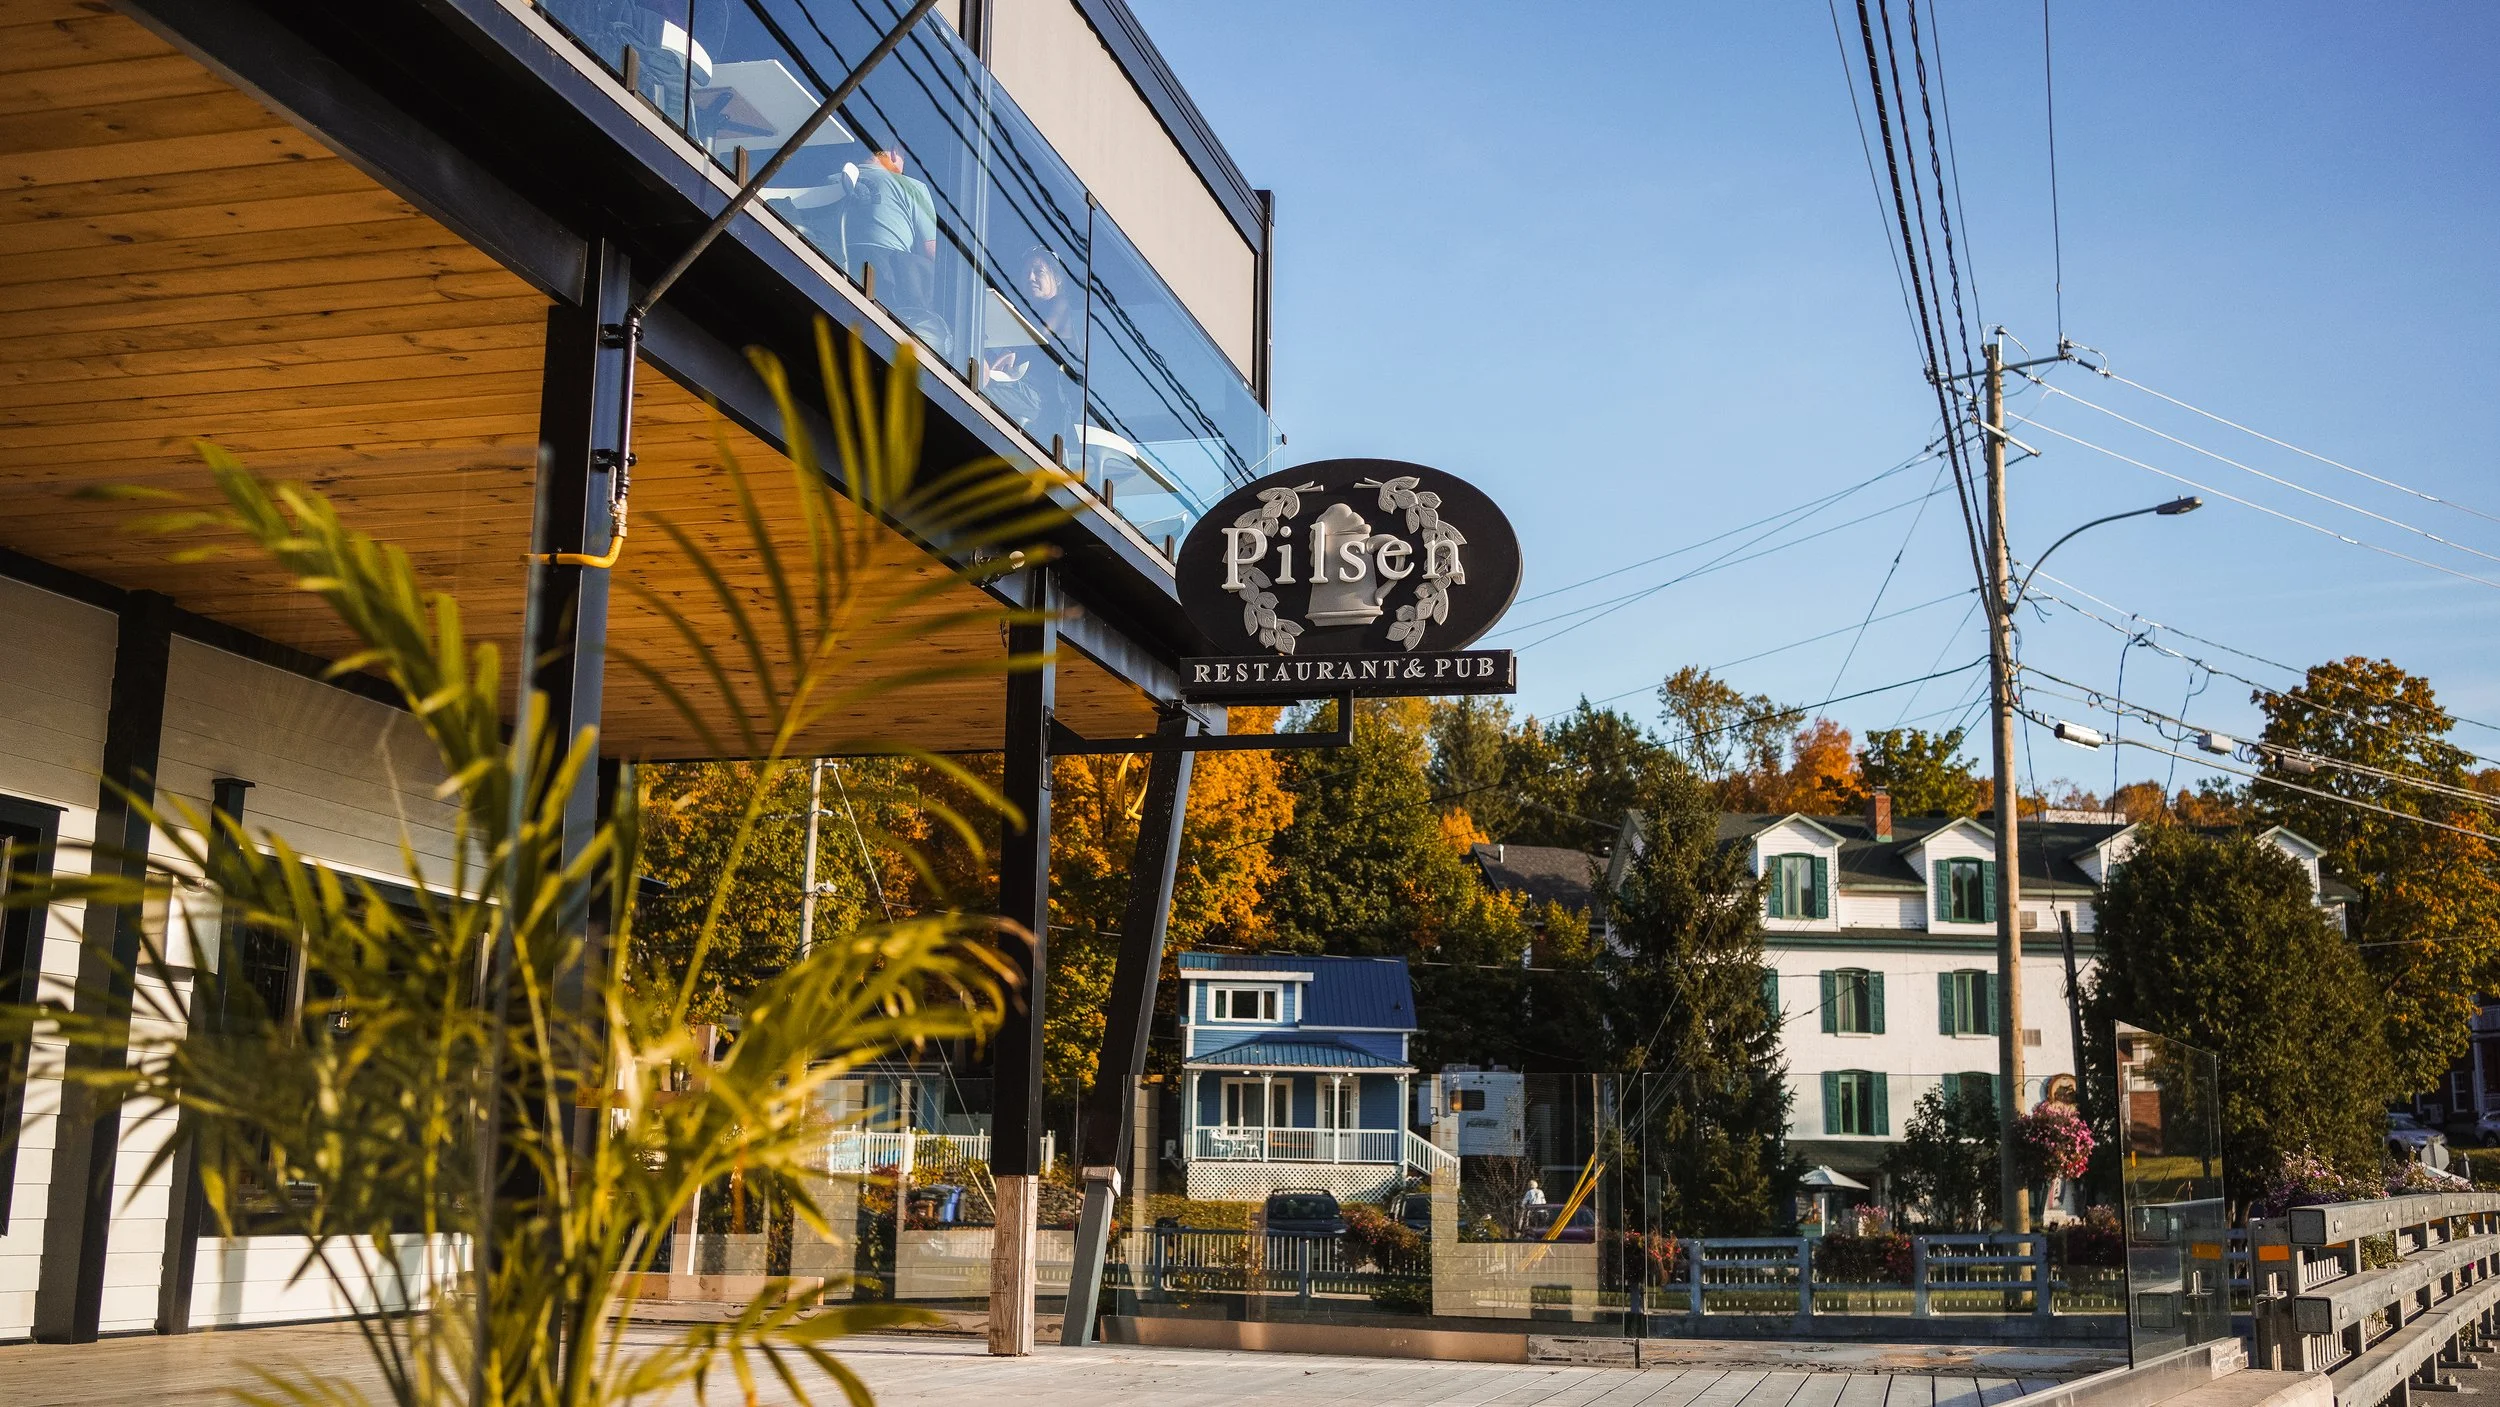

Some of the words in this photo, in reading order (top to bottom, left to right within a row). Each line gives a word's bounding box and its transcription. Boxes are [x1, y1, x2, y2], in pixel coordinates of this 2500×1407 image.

[1221, 521, 1463, 590] Pilsen
[1193, 659, 1399, 683] RESTAURANT
[1403, 657, 1427, 679] &
[1434, 657, 1495, 678] PUB
